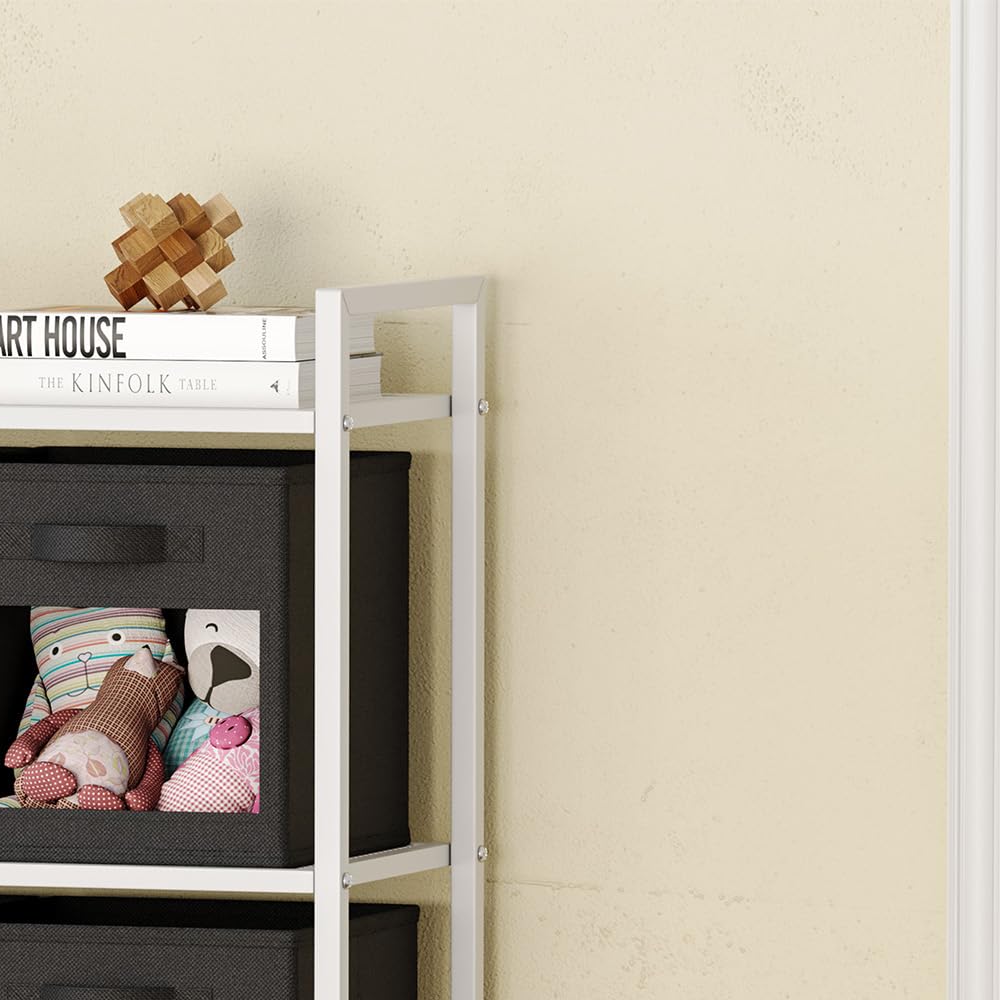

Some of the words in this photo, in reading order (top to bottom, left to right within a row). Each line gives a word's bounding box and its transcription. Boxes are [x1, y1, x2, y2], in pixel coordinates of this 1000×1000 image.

[44, 315, 127, 359] HOUSE
[38, 376, 64, 389] THE
[72, 372, 172, 394] KINFOLK
[178, 378, 217, 391] TABLE
